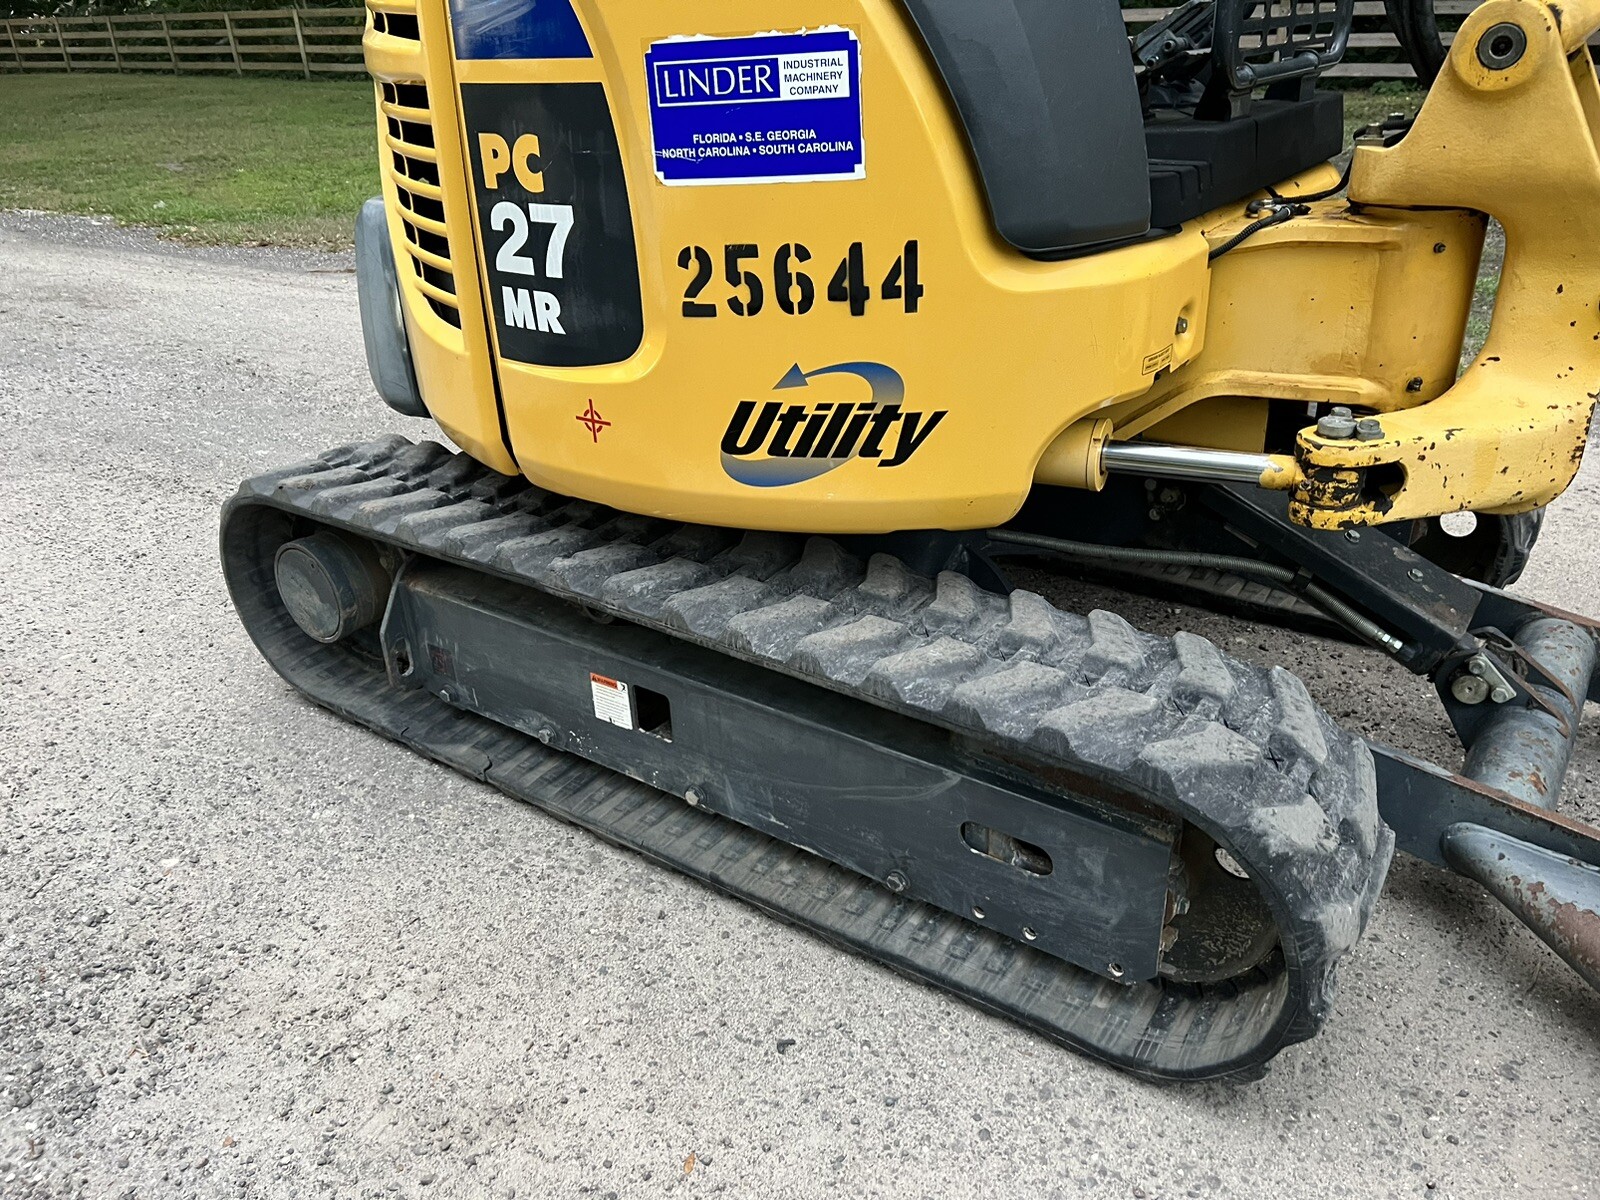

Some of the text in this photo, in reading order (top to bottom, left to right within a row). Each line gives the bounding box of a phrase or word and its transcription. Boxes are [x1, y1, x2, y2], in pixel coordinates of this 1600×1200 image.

[783, 57, 844, 70] INDUSTRIAL
[784, 70, 843, 83] MACHINERY
[664, 65, 774, 98] LINDER
[789, 84, 839, 96] COMPANY
[661, 140, 854, 159] NORTH CAROLINA SOUTH CAROLINA
[692, 129, 817, 144] FLORIDA S.E. GEORGIA
[478, 132, 544, 193] PC
[490, 201, 574, 279] 27
[677, 239, 924, 318] 25644
[502, 285, 567, 335] MR
[720, 400, 949, 468] Utility
